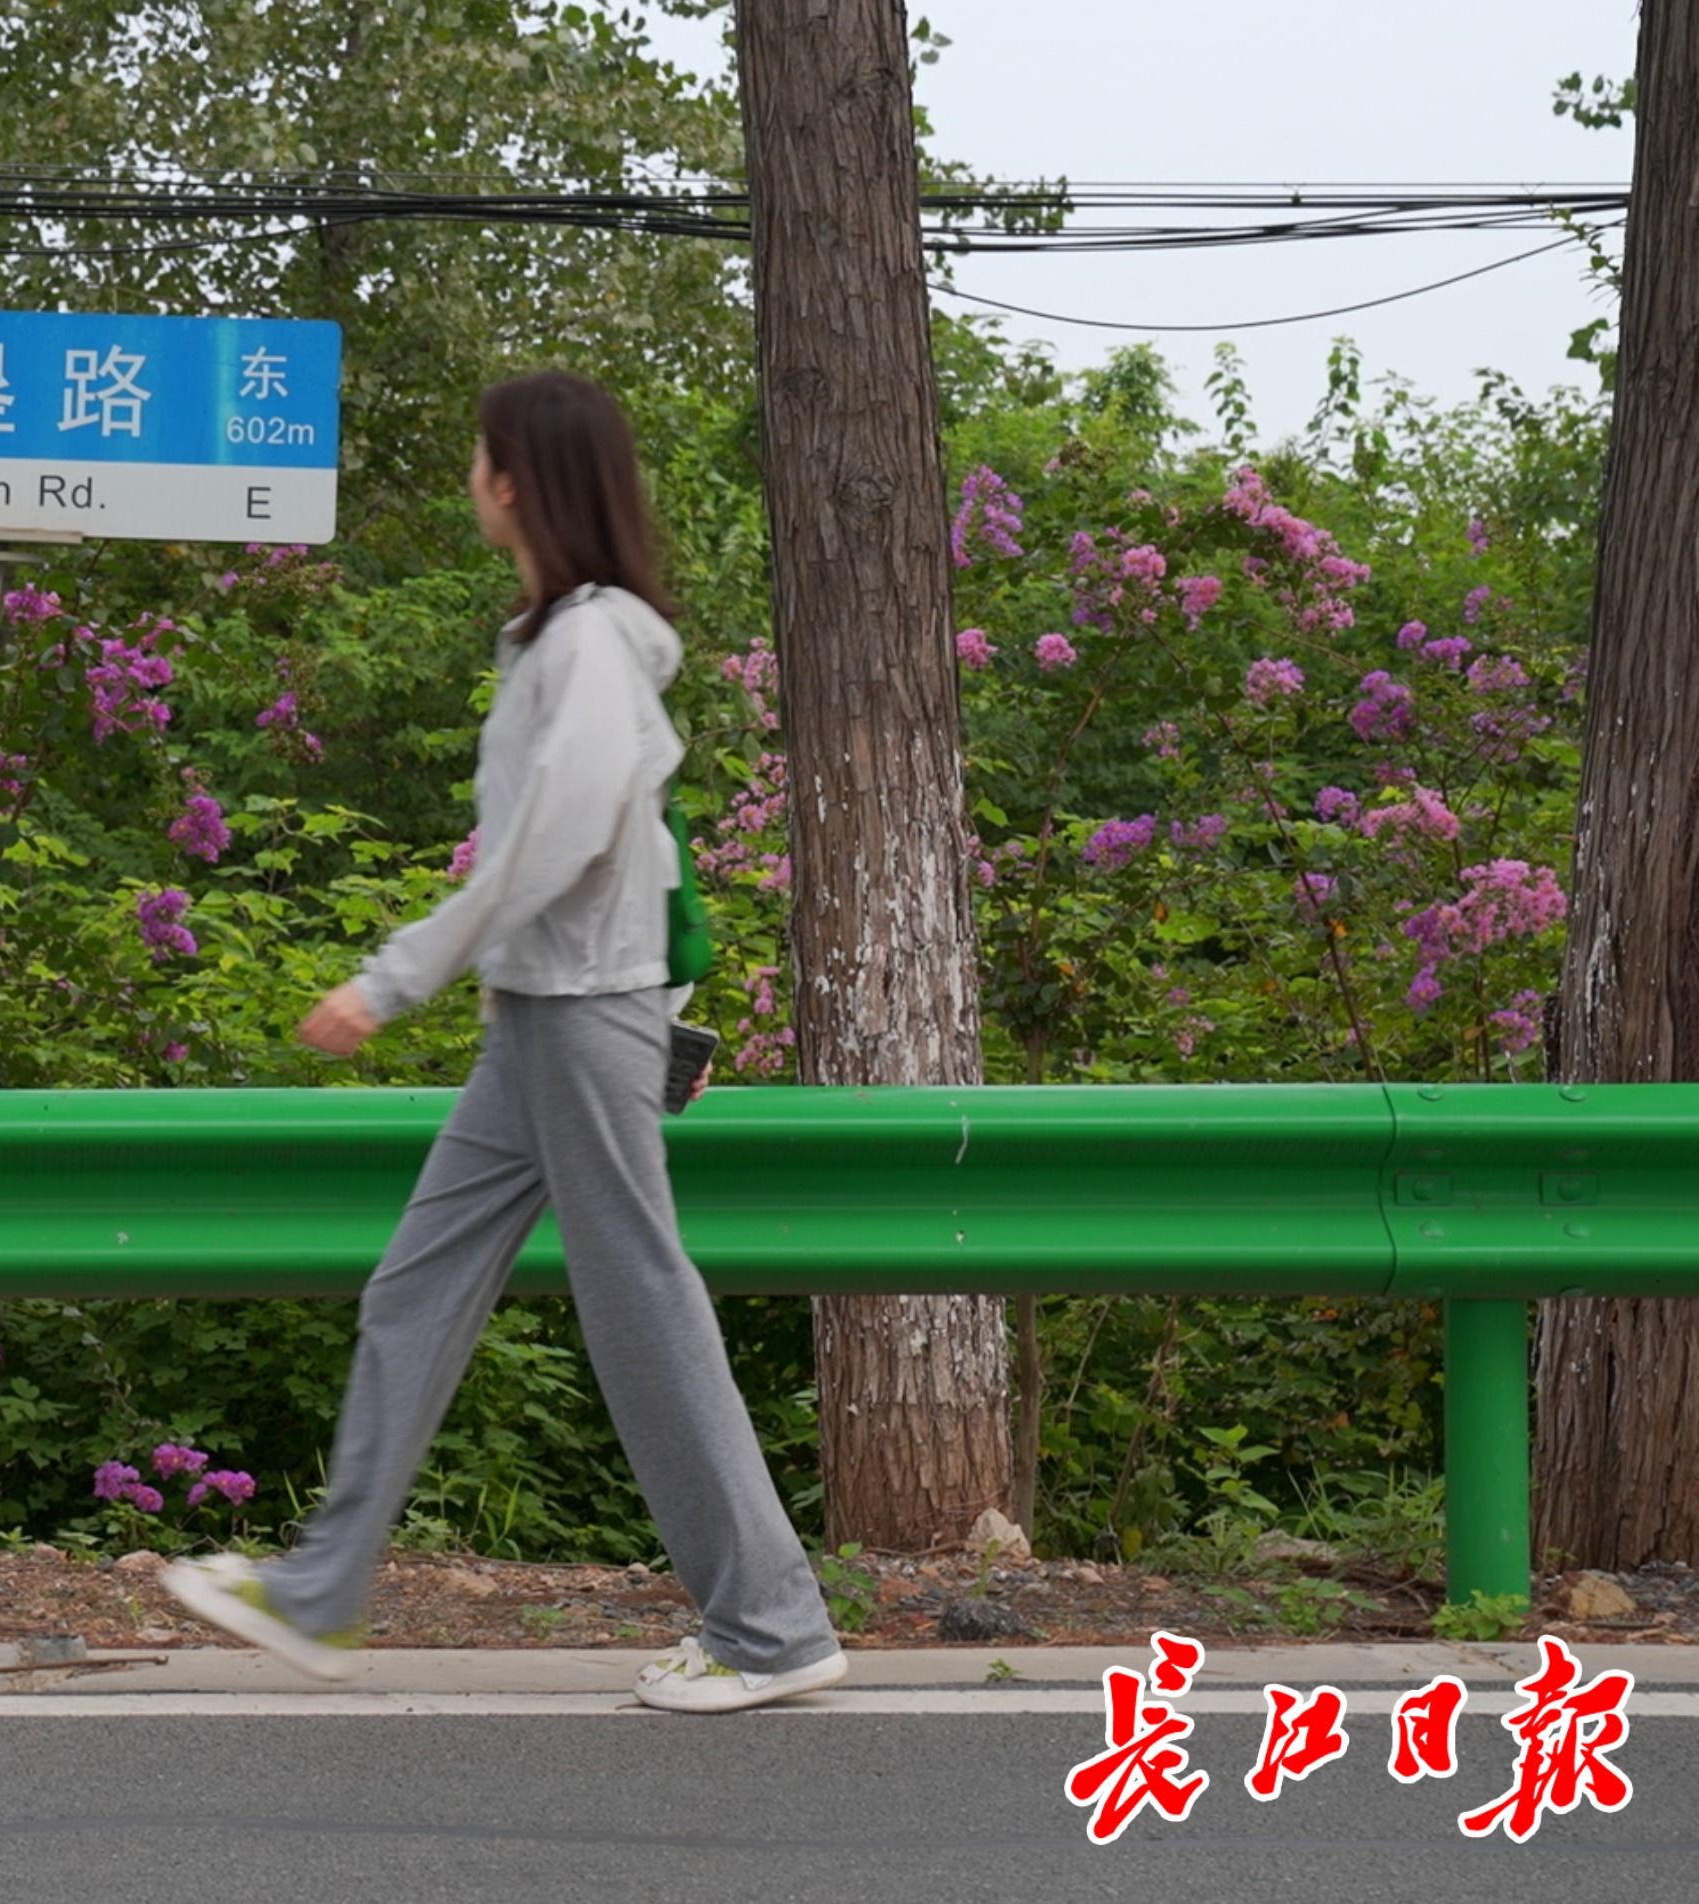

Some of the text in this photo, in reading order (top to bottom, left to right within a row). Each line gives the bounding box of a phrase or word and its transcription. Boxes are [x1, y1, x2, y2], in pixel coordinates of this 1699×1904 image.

[240, 347, 287, 399] 东
[226, 416, 315, 444] 602m
[38, 474, 107, 510] Rd.
[246, 486, 272, 520] E
